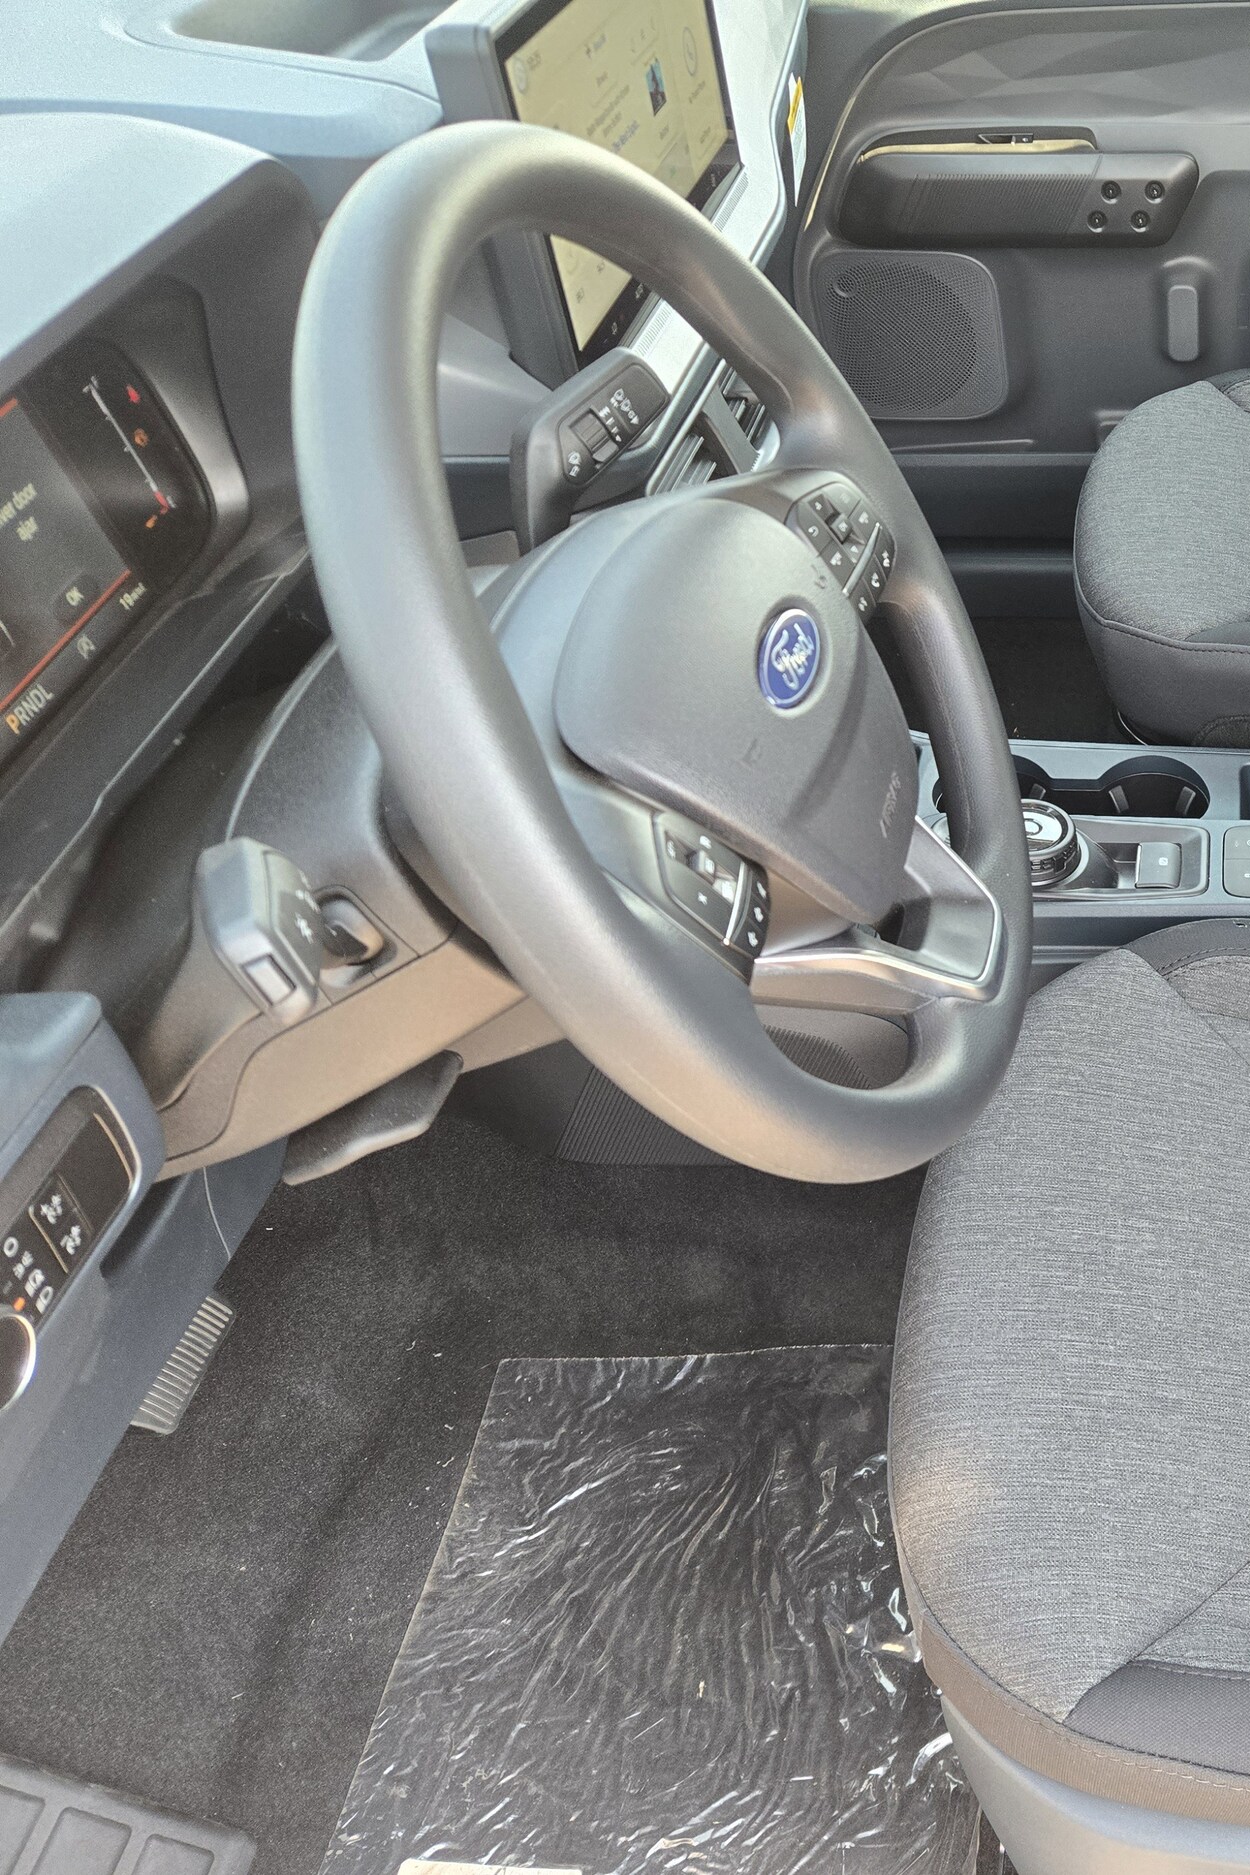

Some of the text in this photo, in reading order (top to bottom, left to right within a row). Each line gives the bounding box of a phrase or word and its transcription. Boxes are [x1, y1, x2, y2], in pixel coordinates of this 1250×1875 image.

[13, 483, 37, 510] door
[16, 516, 38, 541] ajar
[65, 586, 85, 607] OK
[771, 622, 815, 691] Ford
